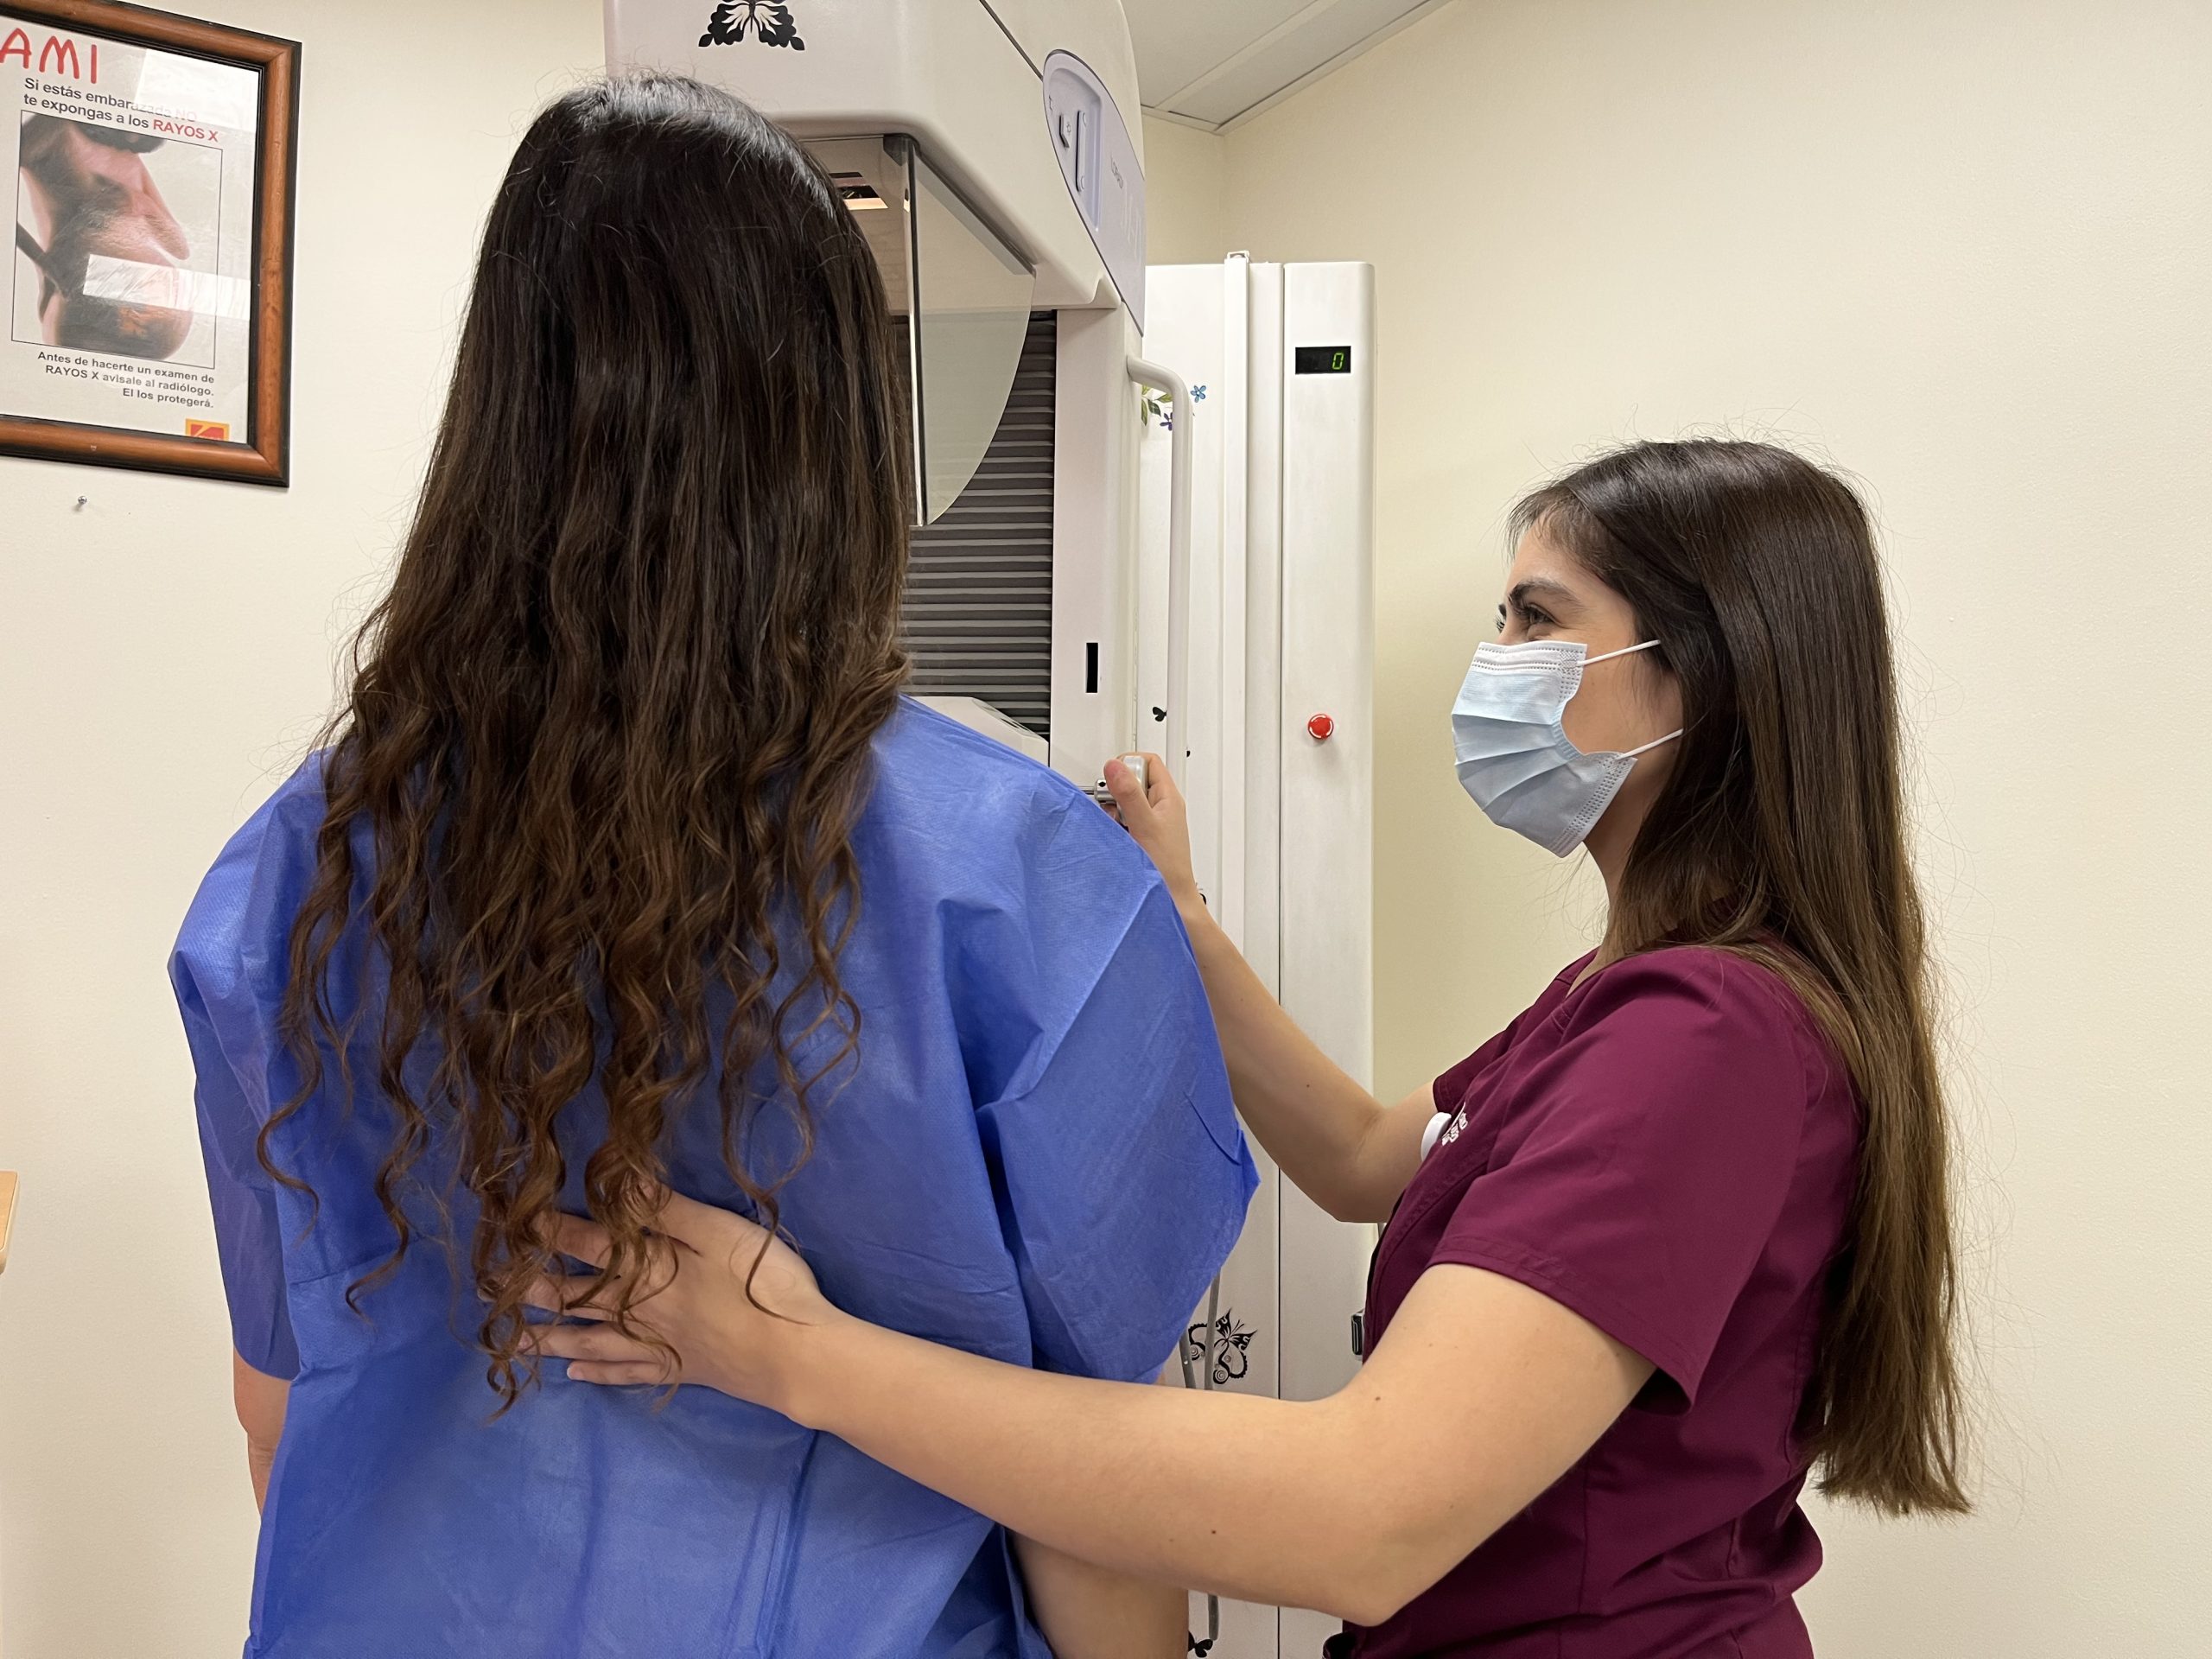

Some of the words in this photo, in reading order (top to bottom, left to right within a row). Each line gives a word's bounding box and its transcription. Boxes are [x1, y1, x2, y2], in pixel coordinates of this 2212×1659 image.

[24, 77, 39, 91] Si
[43, 86, 82, 99] estás
[23, 93, 37, 105] te
[41, 99, 112, 121] expongas
[116, 114, 124, 124] a
[129, 114, 149, 129] los
[153, 119, 206, 139] RAYOS
[207, 130, 219, 143] X
[38, 352, 71, 364] Antes
[74, 357, 88, 365] de
[92, 359, 134, 372] hacerte
[155, 369, 198, 380] examen
[200, 374, 214, 383] de
[1332, 352, 1344, 370] 0
[46, 365, 88, 378] RAYOS
[91, 371, 99, 380] X
[145, 378, 155, 387] al
[158, 382, 214, 397] radiólogo.
[123, 388, 133, 397] El
[137, 390, 154, 399] los
[157, 394, 214, 408] protegerá.
